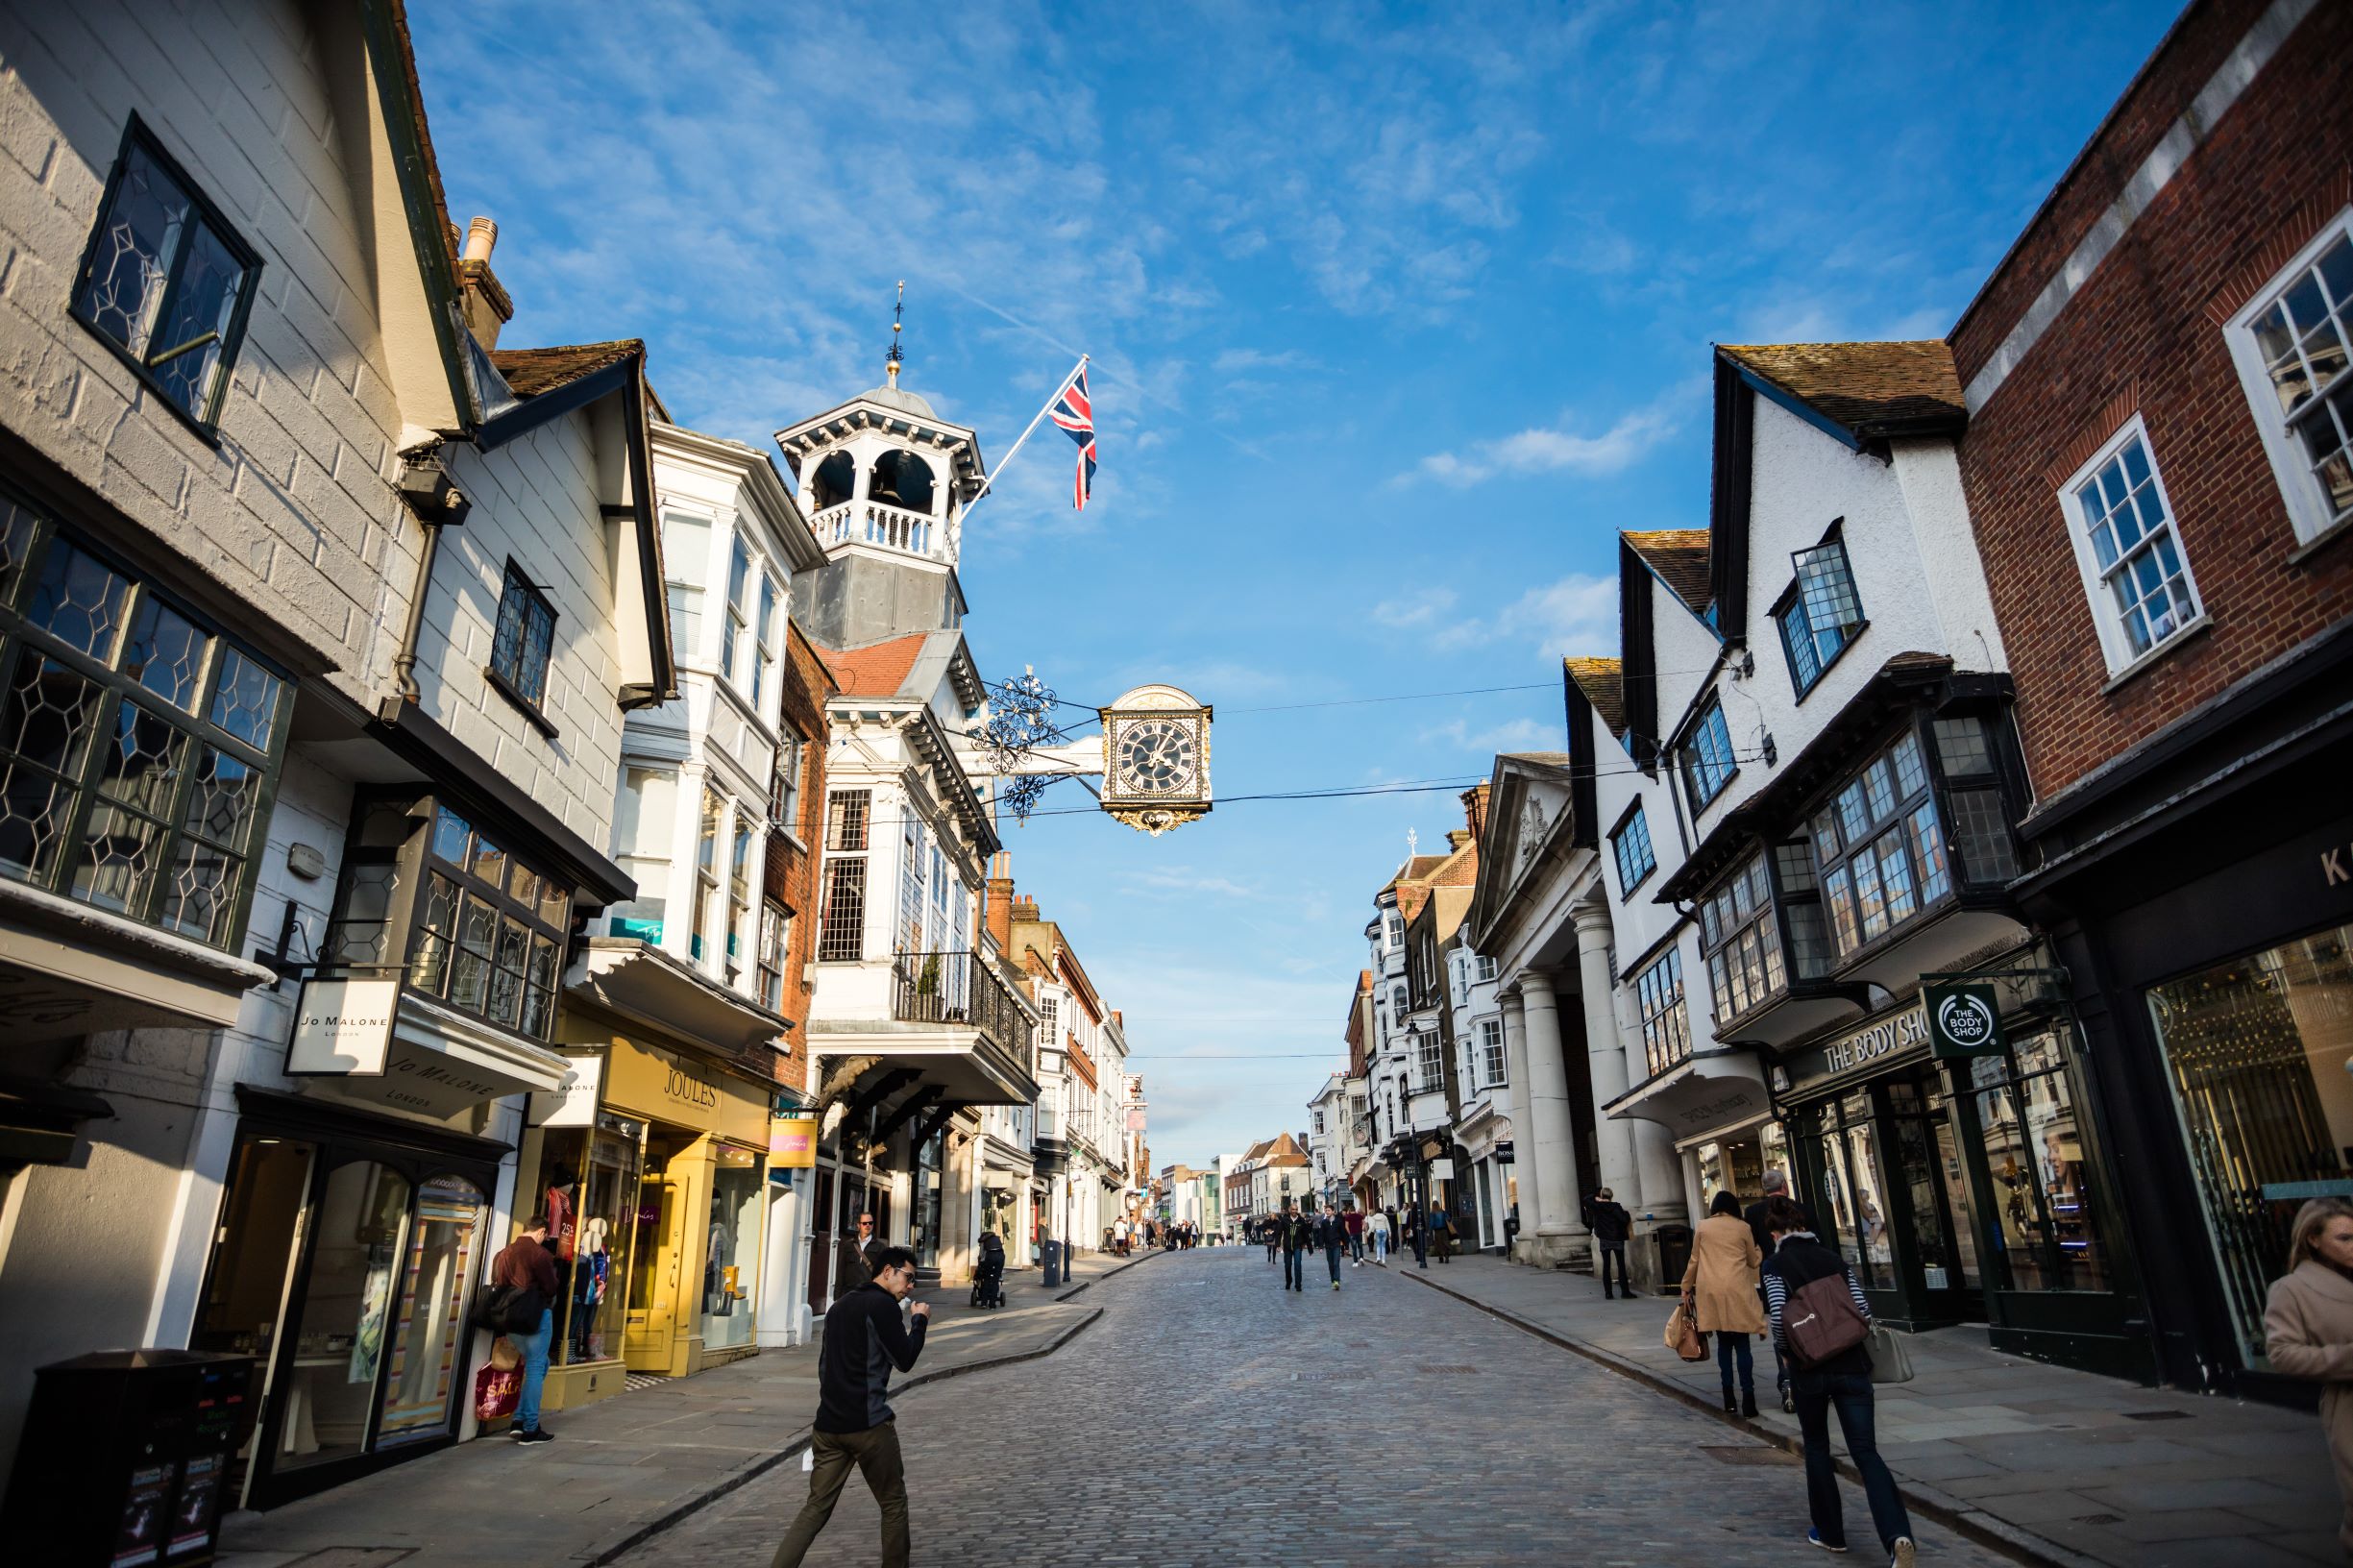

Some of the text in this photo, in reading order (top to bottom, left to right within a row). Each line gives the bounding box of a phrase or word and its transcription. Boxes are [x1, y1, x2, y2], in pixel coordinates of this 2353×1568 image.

[325, 1016, 388, 1026] MALONE
[1954, 1009, 1973, 1017] THE
[1949, 1017, 1982, 1028] BODY
[1824, 1008, 1929, 1073] THE BODY SHO
[1953, 1027, 1983, 1037] SHOP
[416, 1066, 495, 1095] MALONE
[664, 1068, 717, 1108] JOULES
[386, 1090, 430, 1107] LONDON
[624, 1207, 654, 1224] Jules
